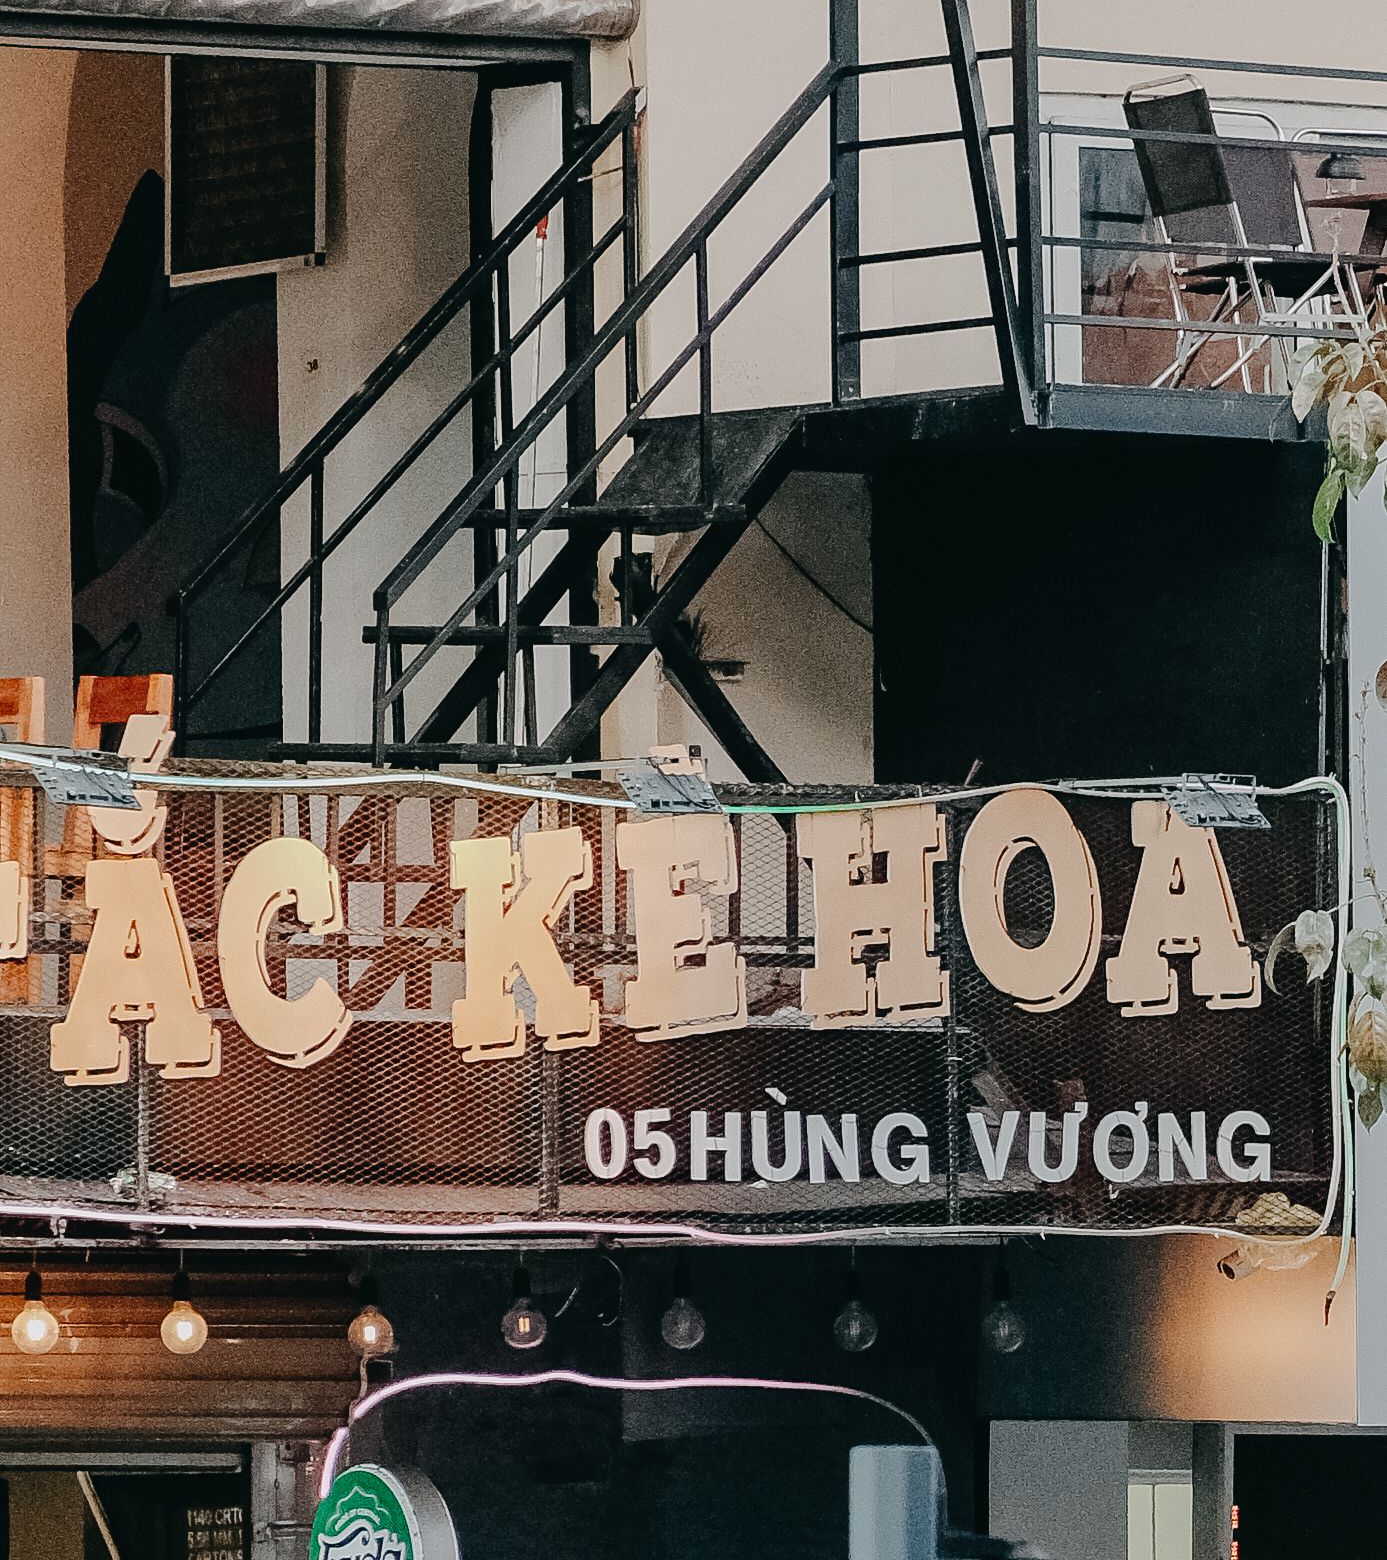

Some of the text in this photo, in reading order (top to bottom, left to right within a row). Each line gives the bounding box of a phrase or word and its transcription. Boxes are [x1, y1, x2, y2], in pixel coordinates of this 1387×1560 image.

[800, 787, 1262, 1030] HOA
[584, 1087, 1272, 1184] 05 HÙNG VƯƠNG
